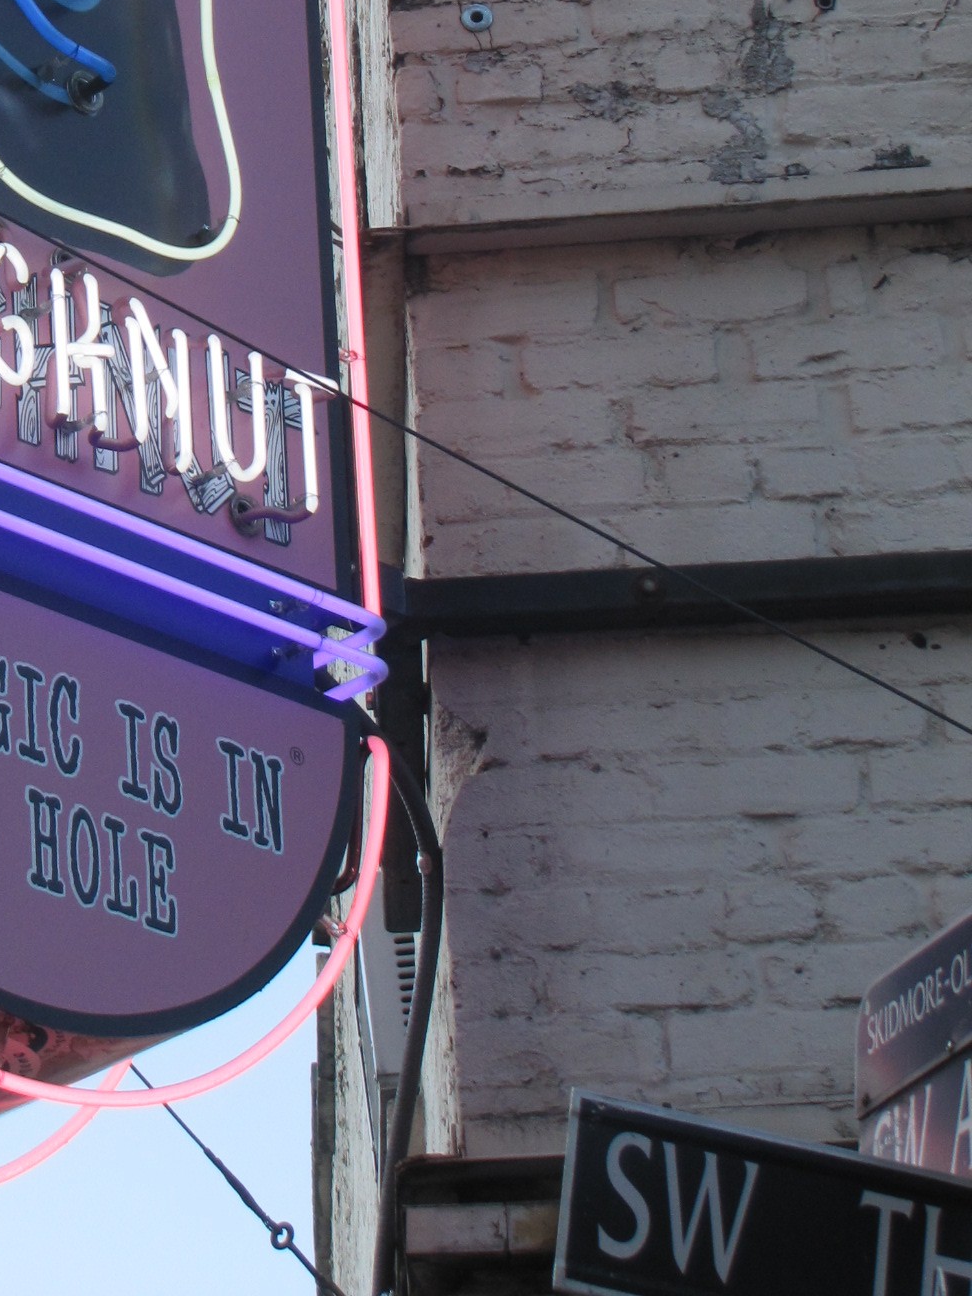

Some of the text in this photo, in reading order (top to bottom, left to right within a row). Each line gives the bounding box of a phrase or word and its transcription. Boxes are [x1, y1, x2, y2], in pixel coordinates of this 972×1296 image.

[115, 699, 184, 818] IS
[216, 737, 285, 855] IN
[25, 784, 179, 938] HOLE
[597, 1130, 760, 1286] SW
